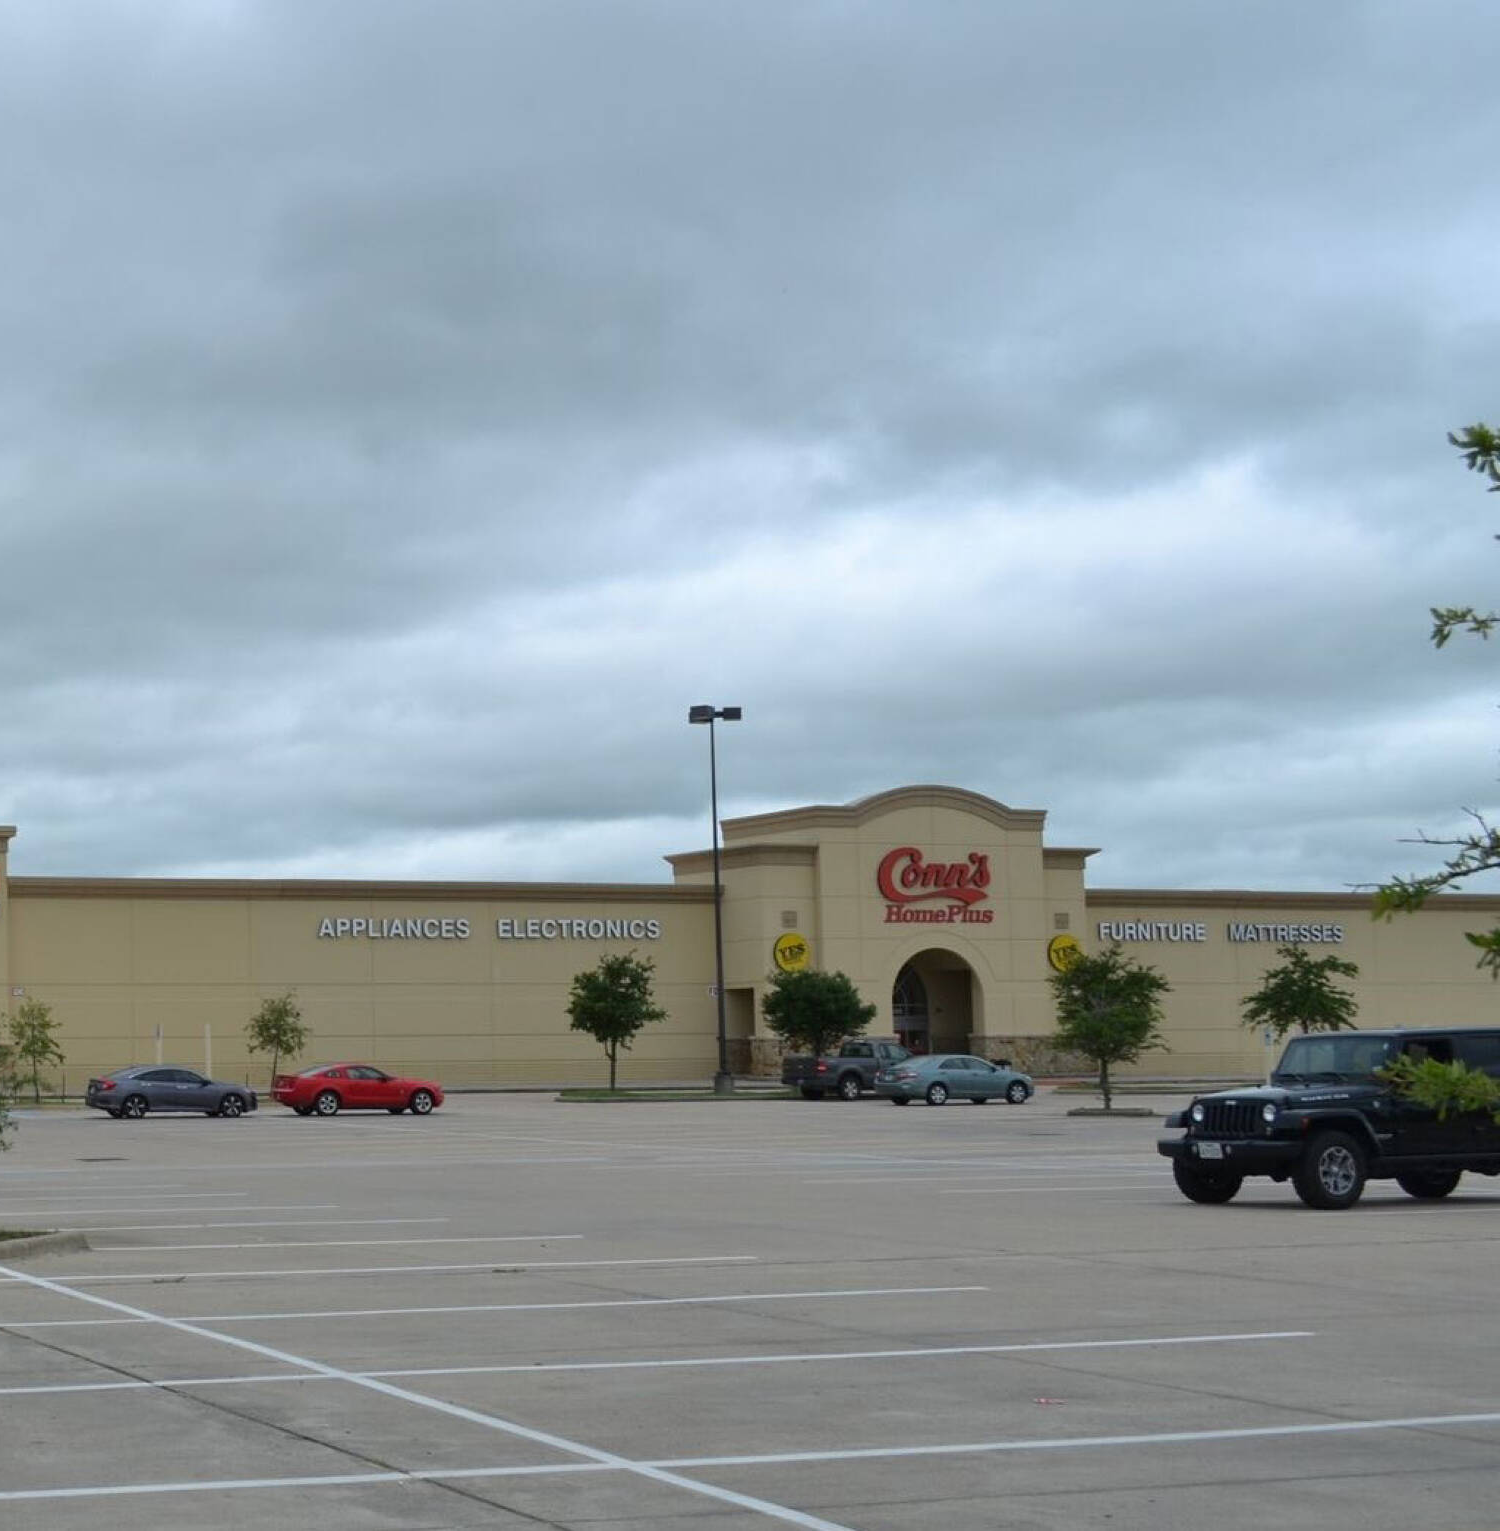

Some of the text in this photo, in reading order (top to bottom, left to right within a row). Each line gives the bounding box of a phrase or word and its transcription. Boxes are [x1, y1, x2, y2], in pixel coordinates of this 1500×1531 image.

[877, 847, 991, 905] Conn's
[884, 904, 994, 924] HomePlus
[318, 918, 471, 939] APPLIANCES
[497, 919, 662, 940] ELECTRONICS
[1098, 921, 1207, 942] FURNITURE
[1228, 923, 1344, 943] MATTRESSES
